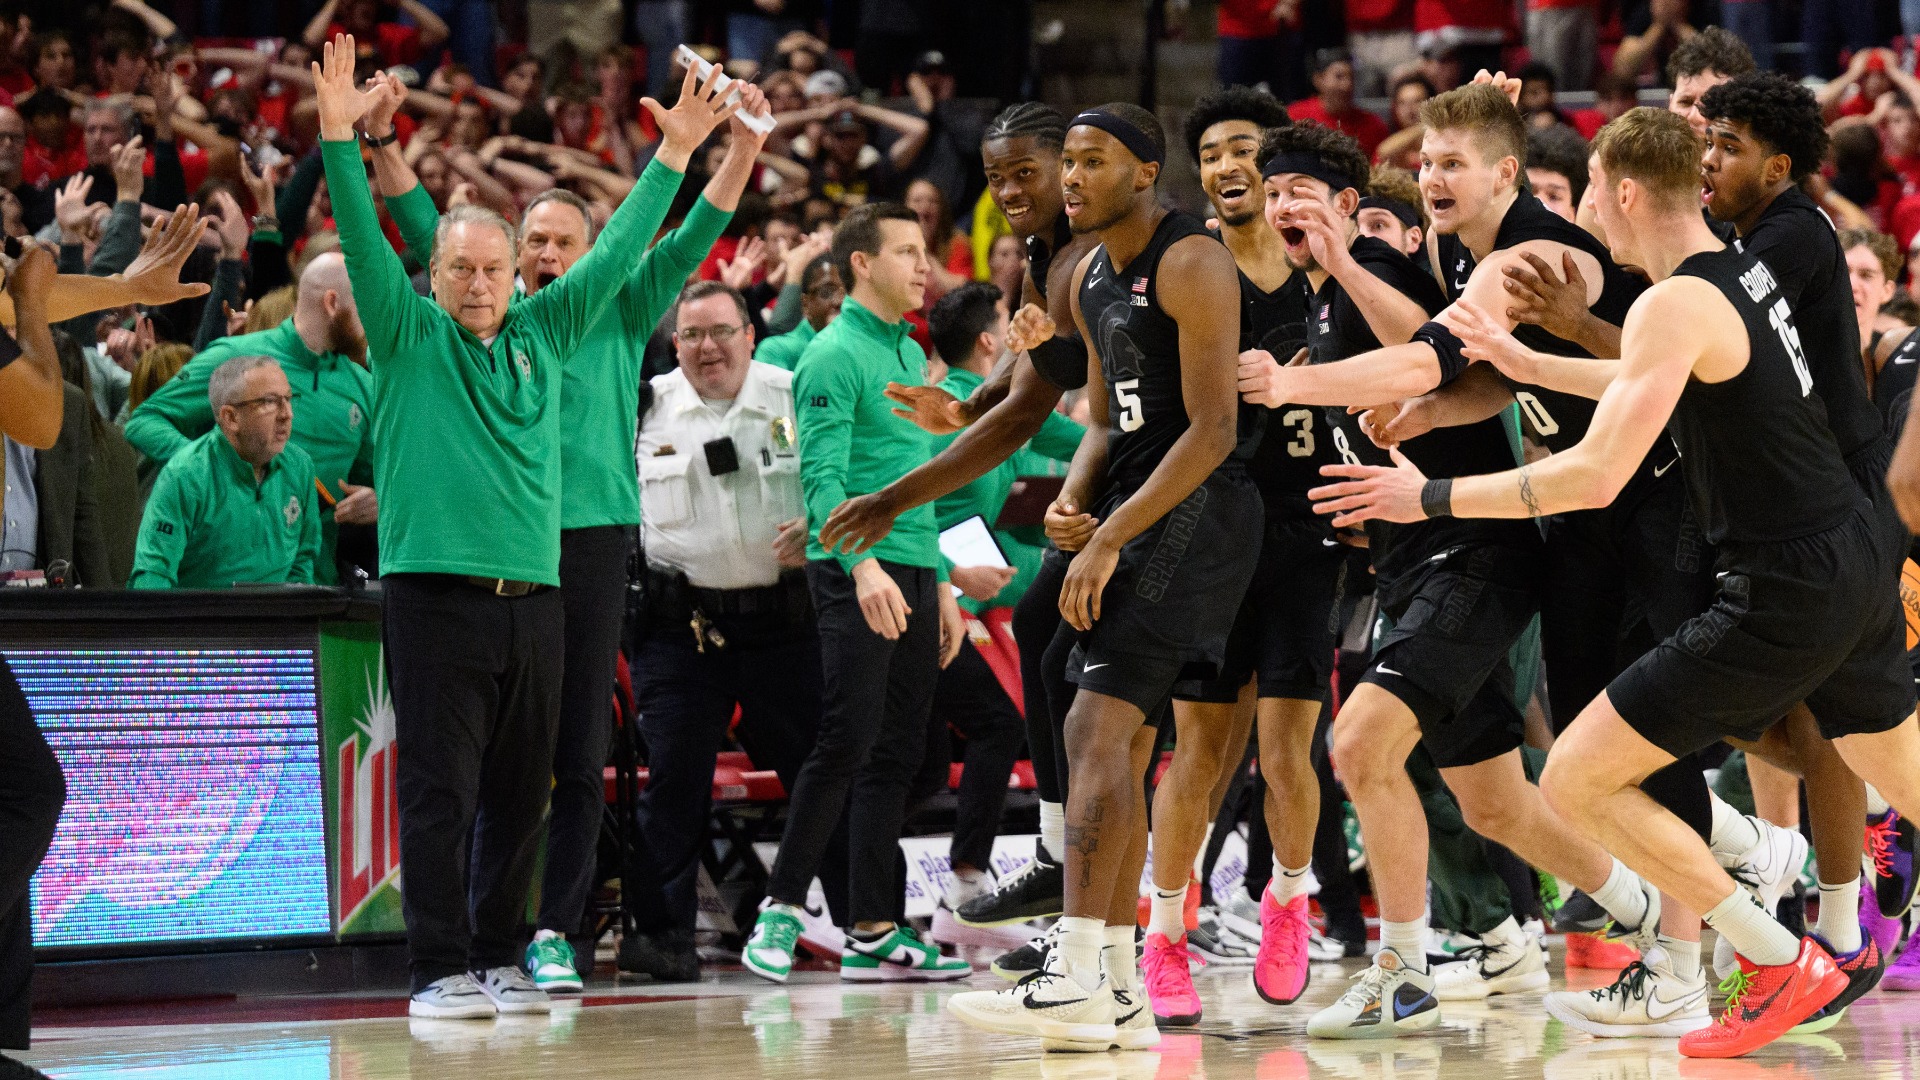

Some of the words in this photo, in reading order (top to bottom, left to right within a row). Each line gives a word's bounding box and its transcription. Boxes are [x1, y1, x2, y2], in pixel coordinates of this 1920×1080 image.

[1738, 260, 1778, 303] COOPE
[1768, 296, 1814, 398] 15
[1115, 378, 1145, 433] 5
[1515, 391, 1560, 437] 0
[1283, 409, 1315, 458] 3
[1332, 426, 1362, 466] 8
